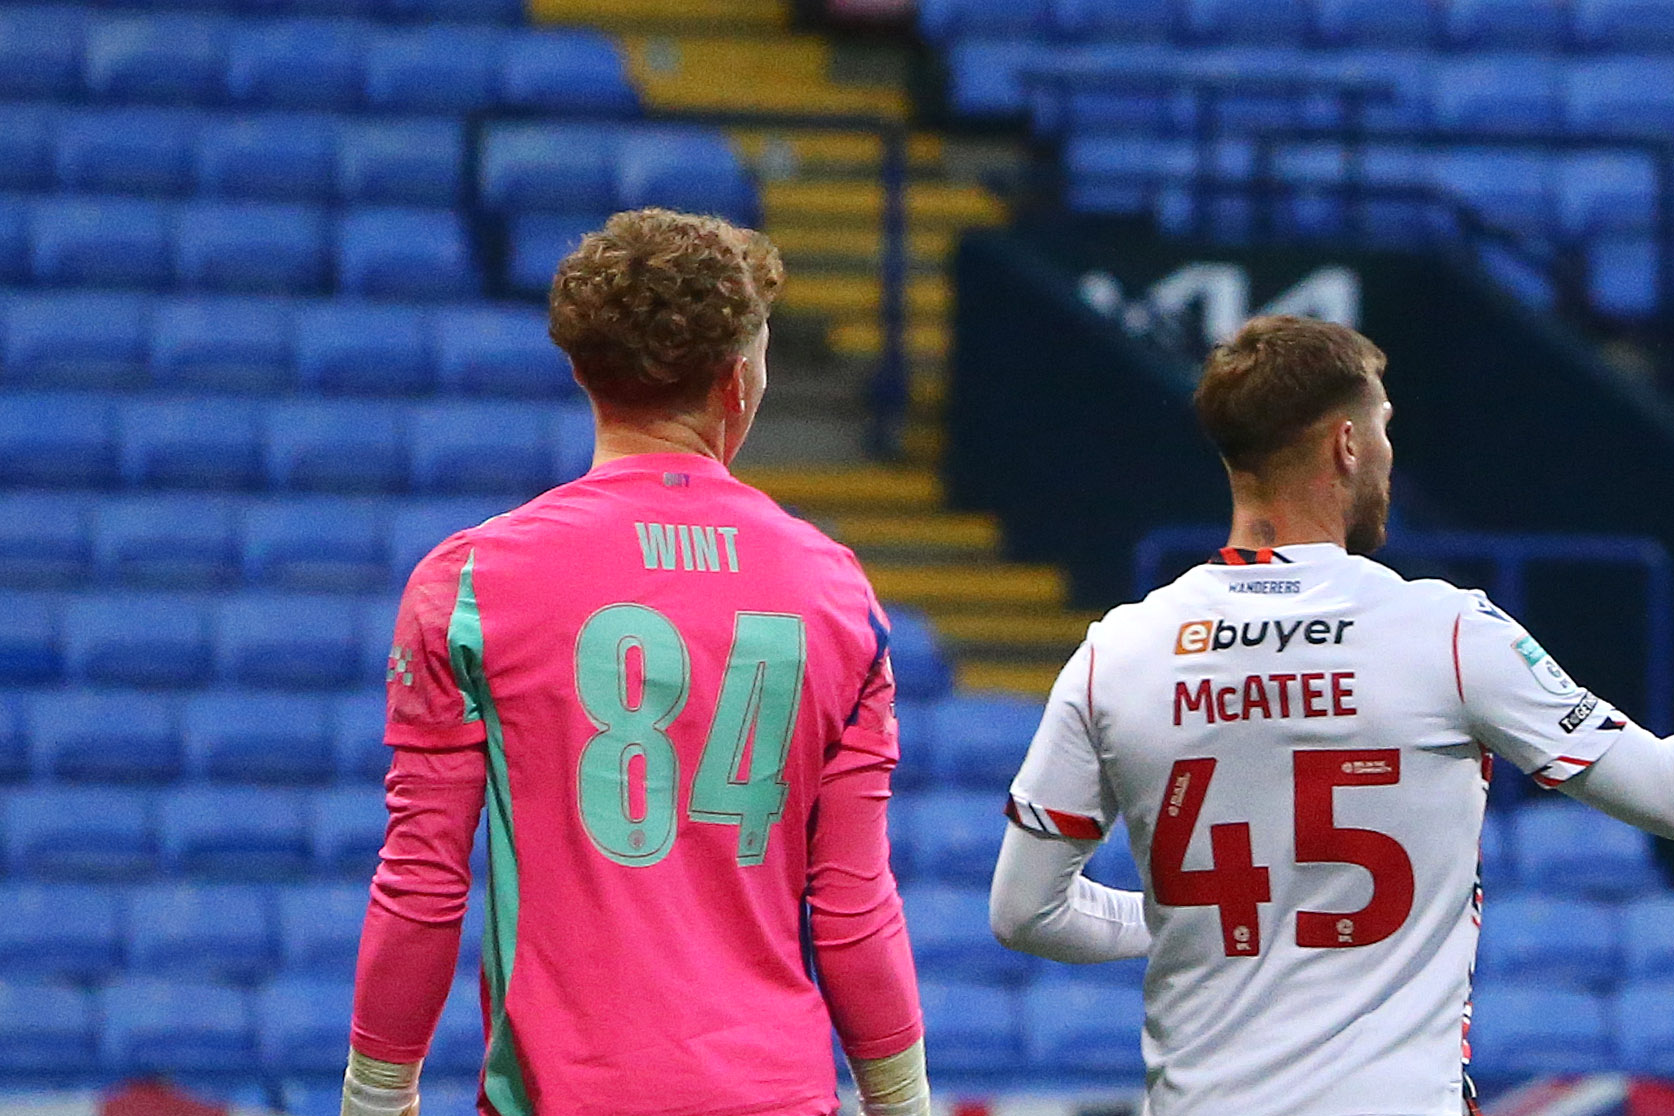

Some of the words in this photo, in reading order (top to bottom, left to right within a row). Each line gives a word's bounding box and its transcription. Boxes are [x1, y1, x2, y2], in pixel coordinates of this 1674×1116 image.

[634, 522, 739, 573] WINT
[1228, 580, 1302, 595] WANDERERS
[1177, 619, 1355, 655] ebuyer
[1173, 672, 1357, 726] McATEE
[574, 602, 807, 867] 84
[1151, 748, 1415, 957] 45
